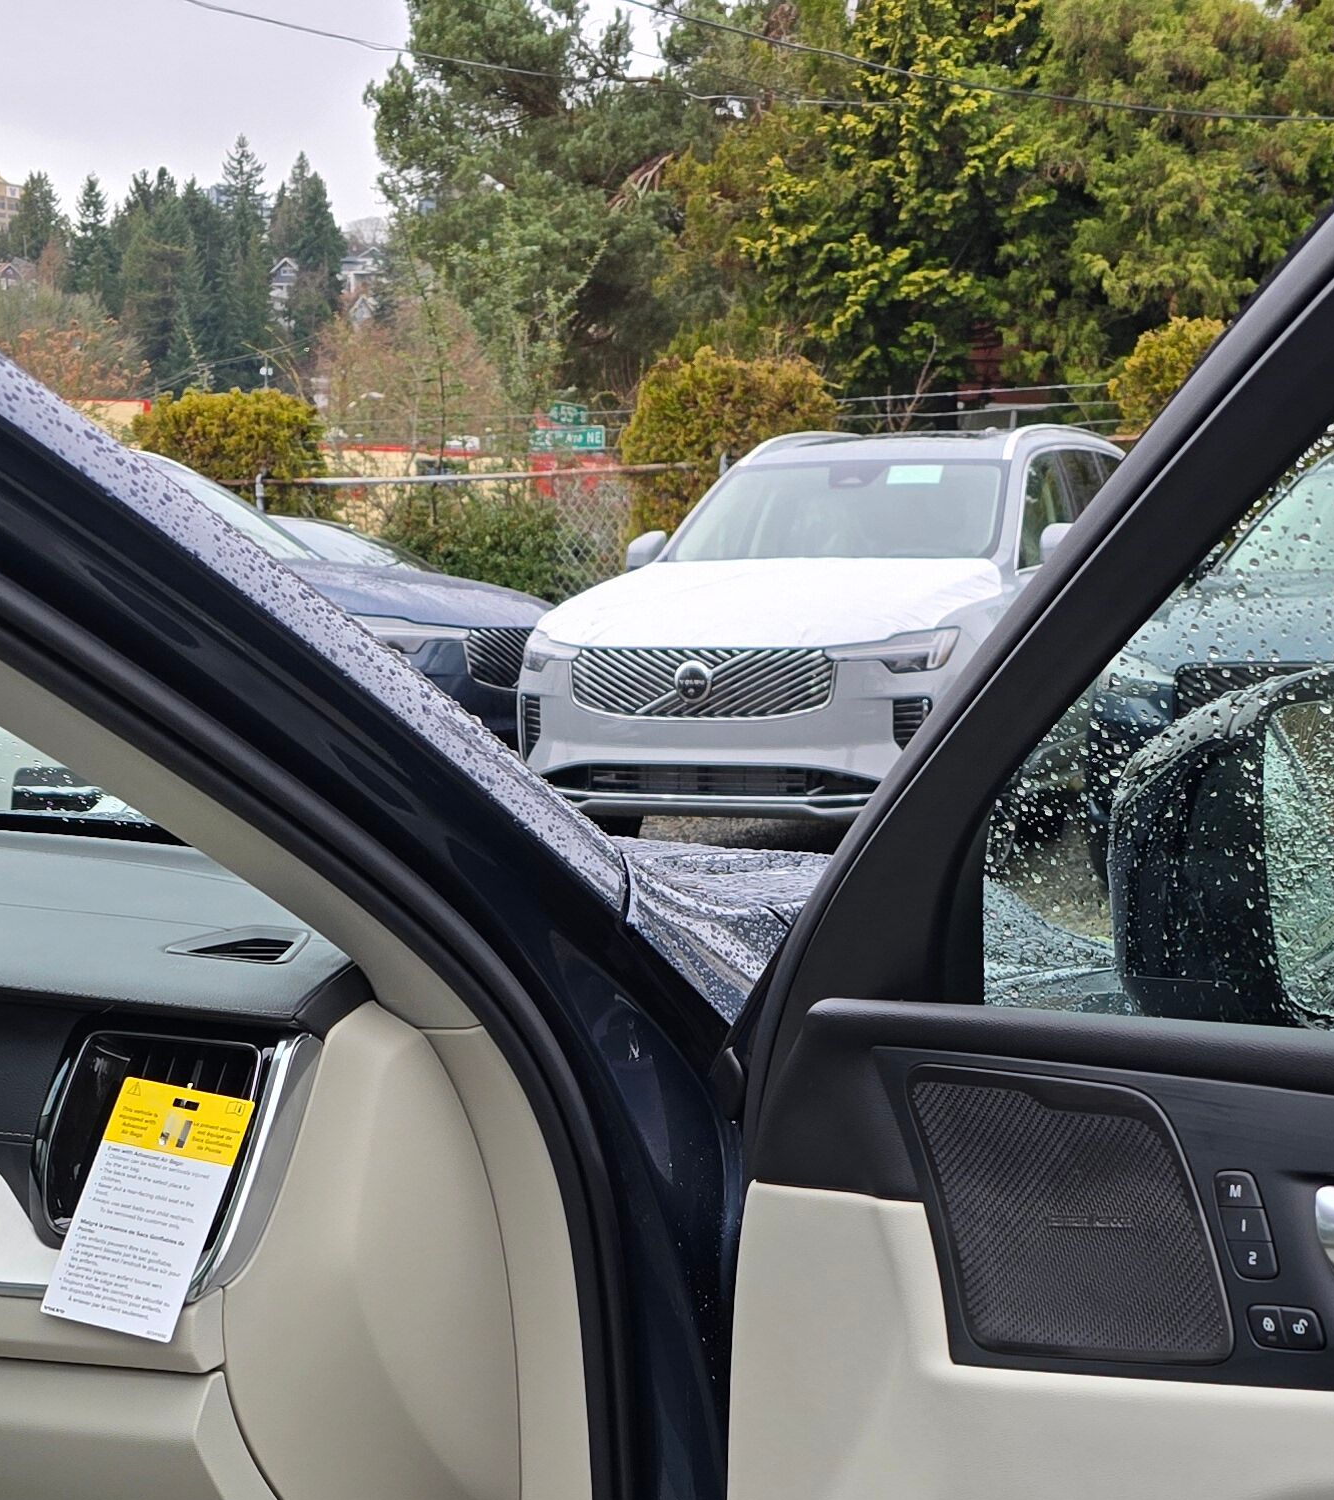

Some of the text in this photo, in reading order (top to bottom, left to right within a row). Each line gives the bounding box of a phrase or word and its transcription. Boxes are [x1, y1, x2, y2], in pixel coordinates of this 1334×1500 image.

[587, 431, 602, 444] NE
[1229, 1185, 1242, 1198] M
[1248, 1251, 1258, 1265] 2
